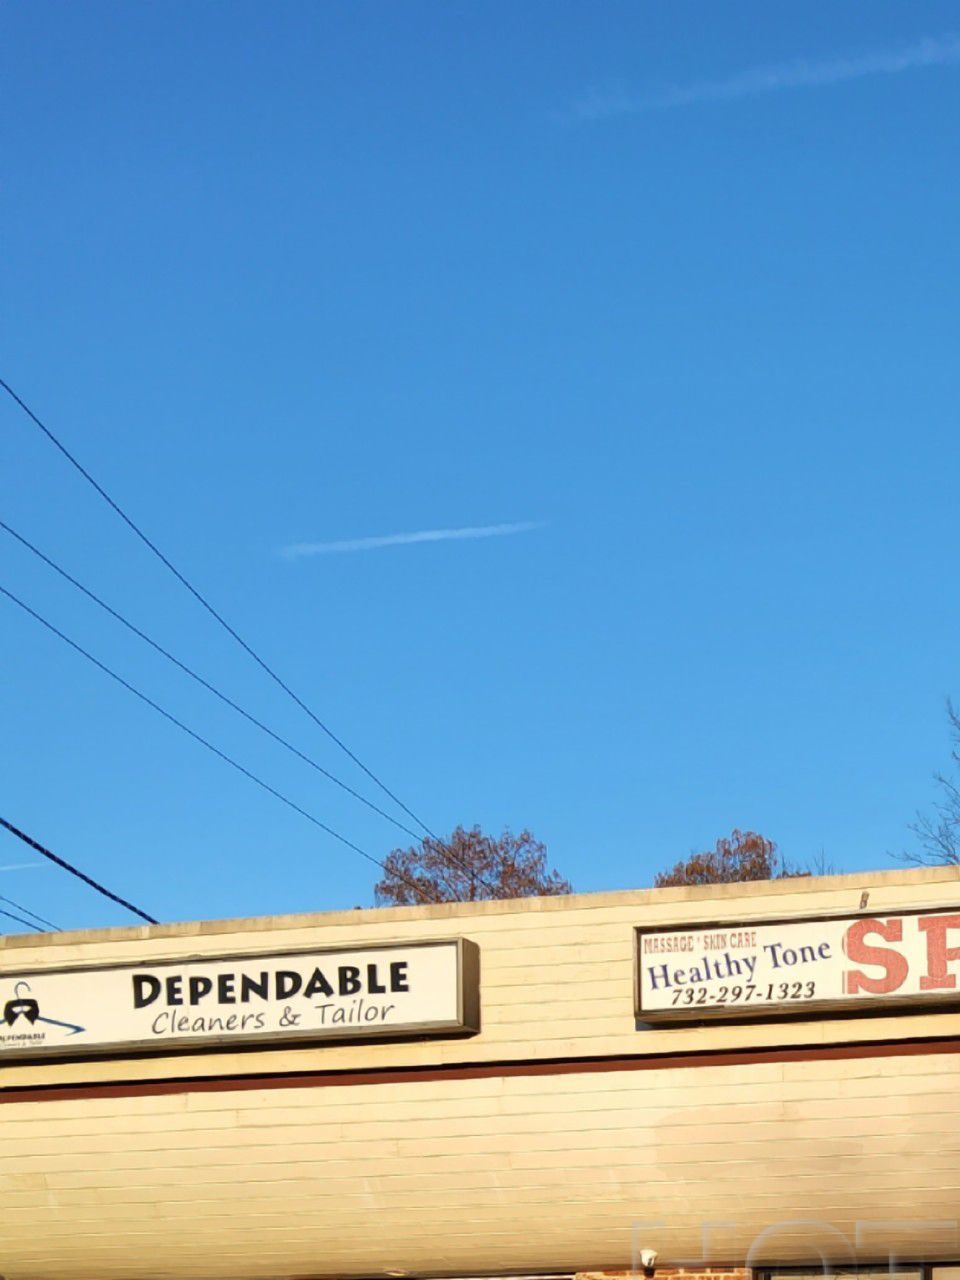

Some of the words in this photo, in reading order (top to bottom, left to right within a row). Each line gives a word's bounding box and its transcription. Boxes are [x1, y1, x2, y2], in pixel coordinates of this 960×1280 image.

[644, 936, 694, 954] MASSAGE
[704, 934, 727, 951] SKIN
[730, 932, 757, 949] CARE
[648, 951, 757, 990] Healthy
[763, 941, 832, 969] Tone
[132, 961, 410, 1009] DEPENDABLE
[672, 981, 816, 1005] 732-297-1323
[151, 1007, 266, 1035] Cleaners
[279, 1007, 301, 1028] &
[315, 999, 396, 1024] Tailor
